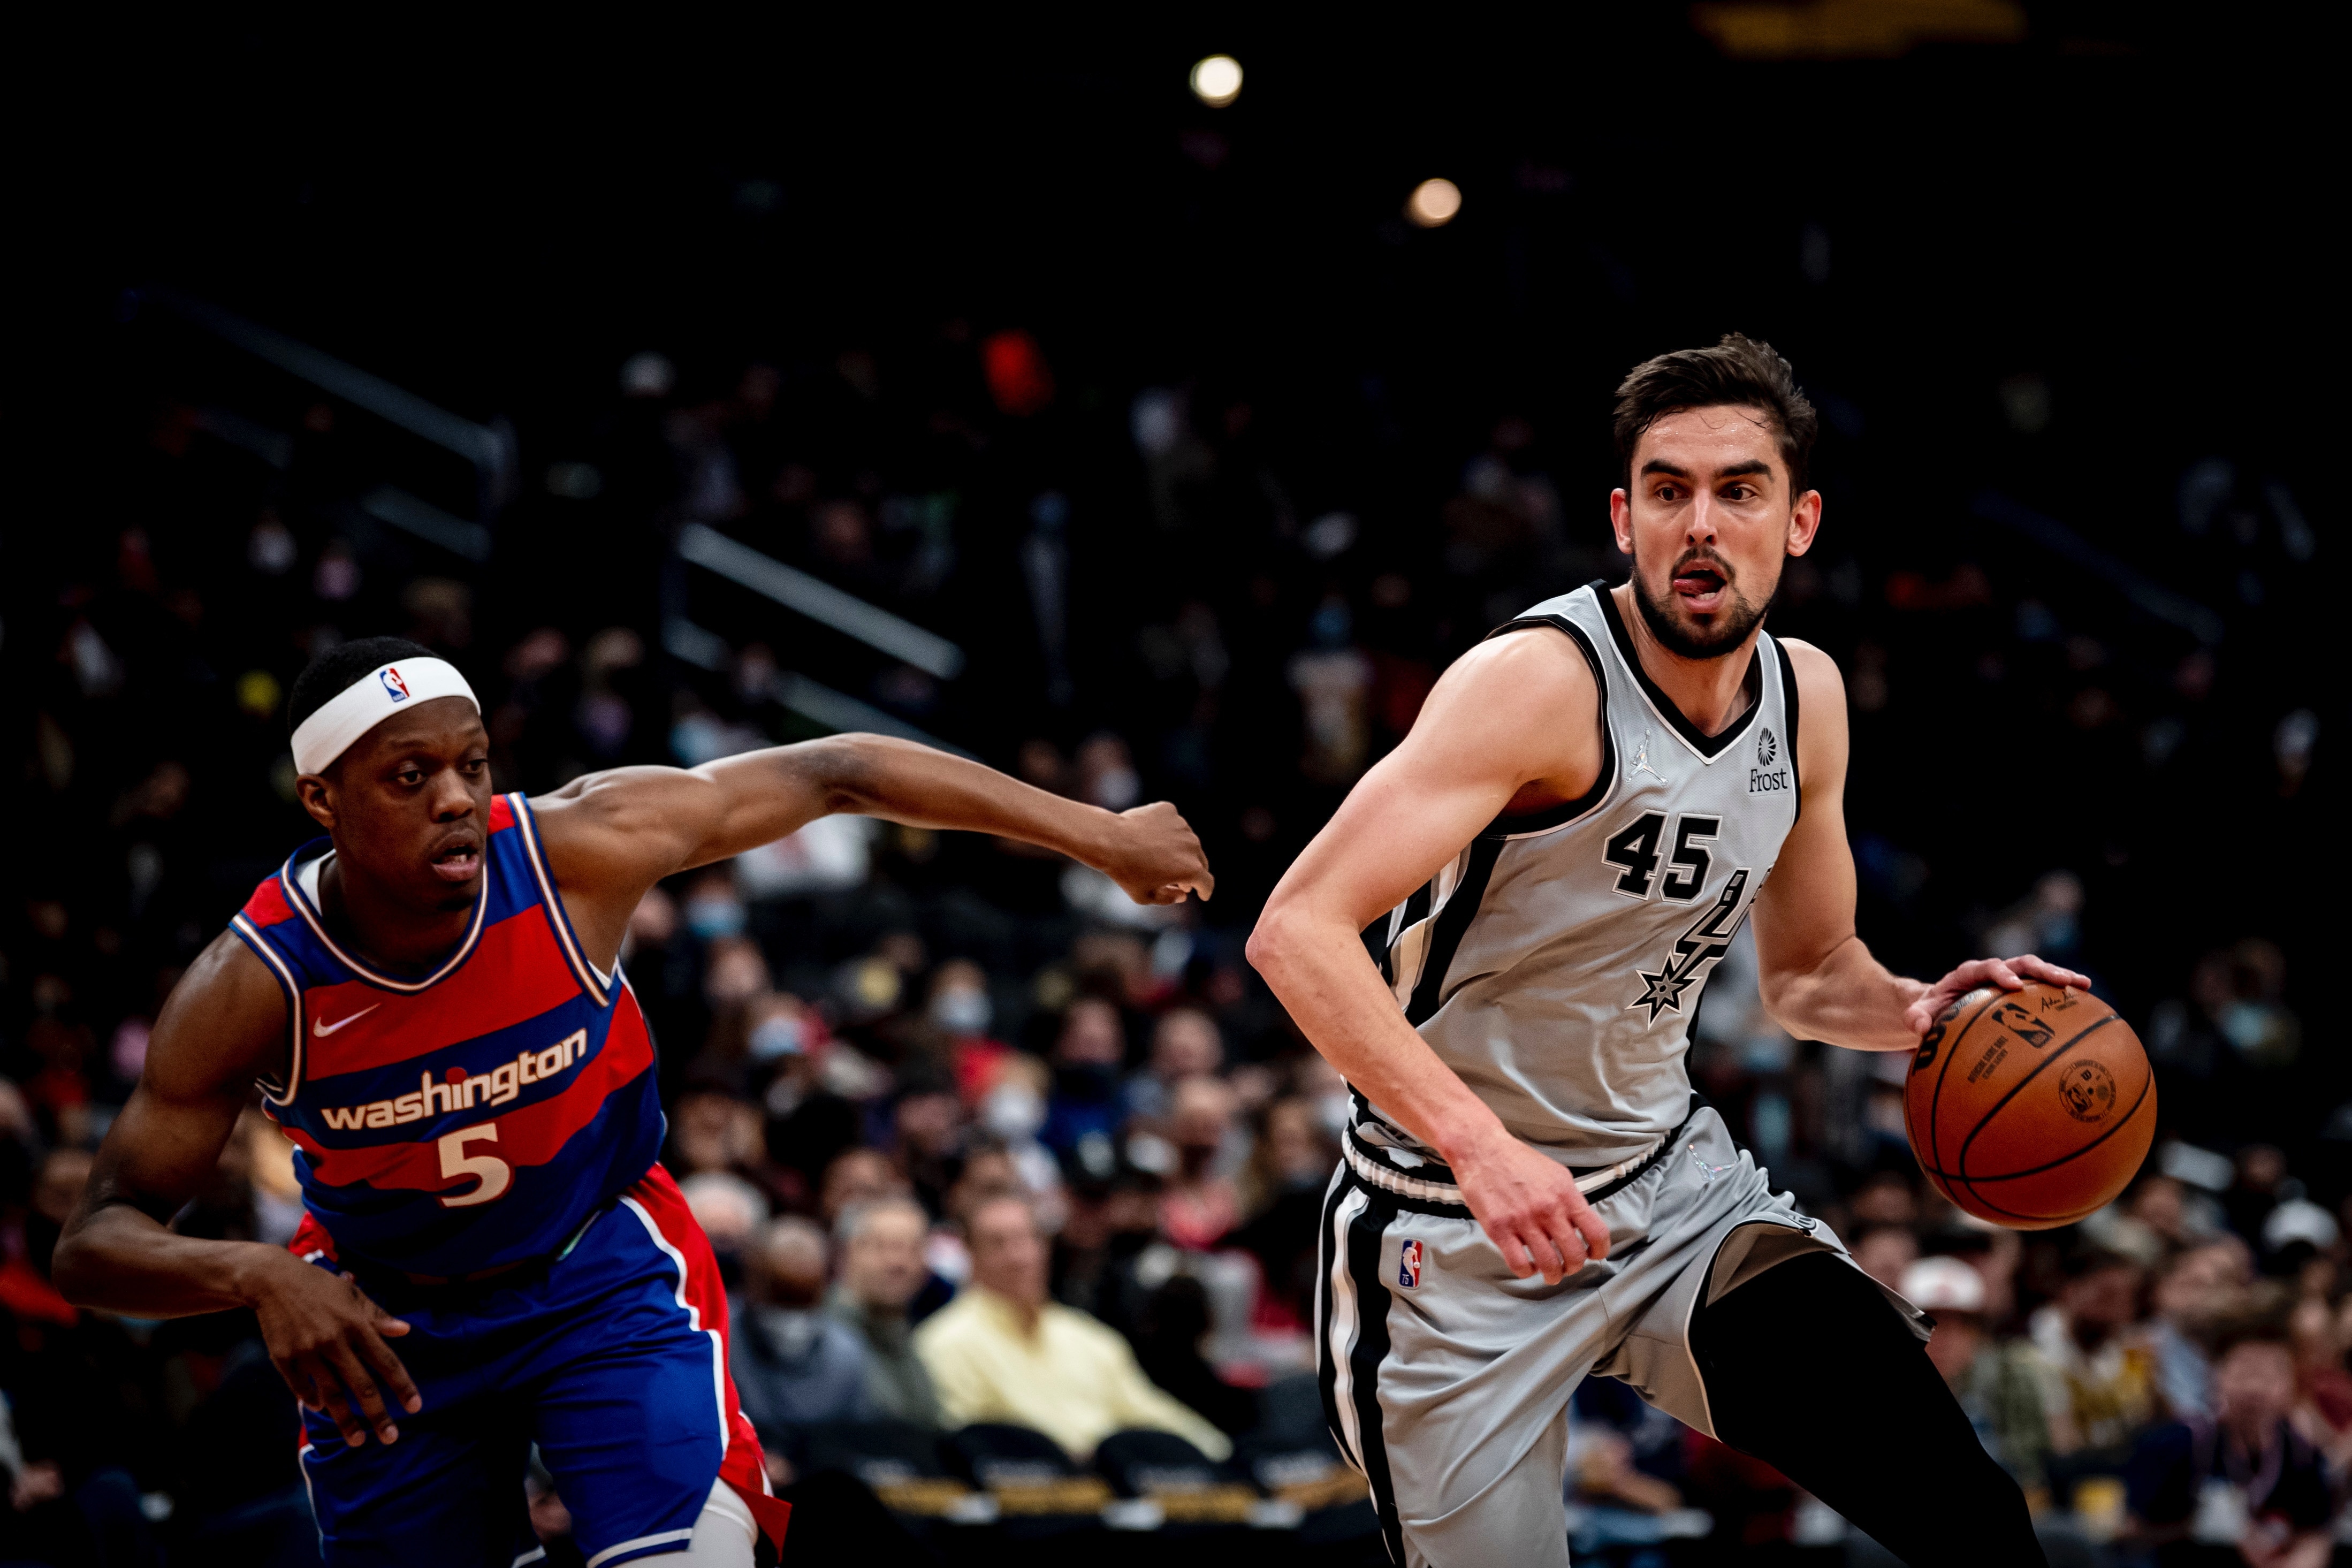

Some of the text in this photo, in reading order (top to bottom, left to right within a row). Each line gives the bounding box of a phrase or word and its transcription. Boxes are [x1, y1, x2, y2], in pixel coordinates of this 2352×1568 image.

[1749, 767, 1788, 793] Frost
[1601, 809, 1723, 905] 45
[321, 1027, 588, 1130] washington
[436, 1122, 512, 1208] 5
[1402, 1274, 1410, 1284] 75
